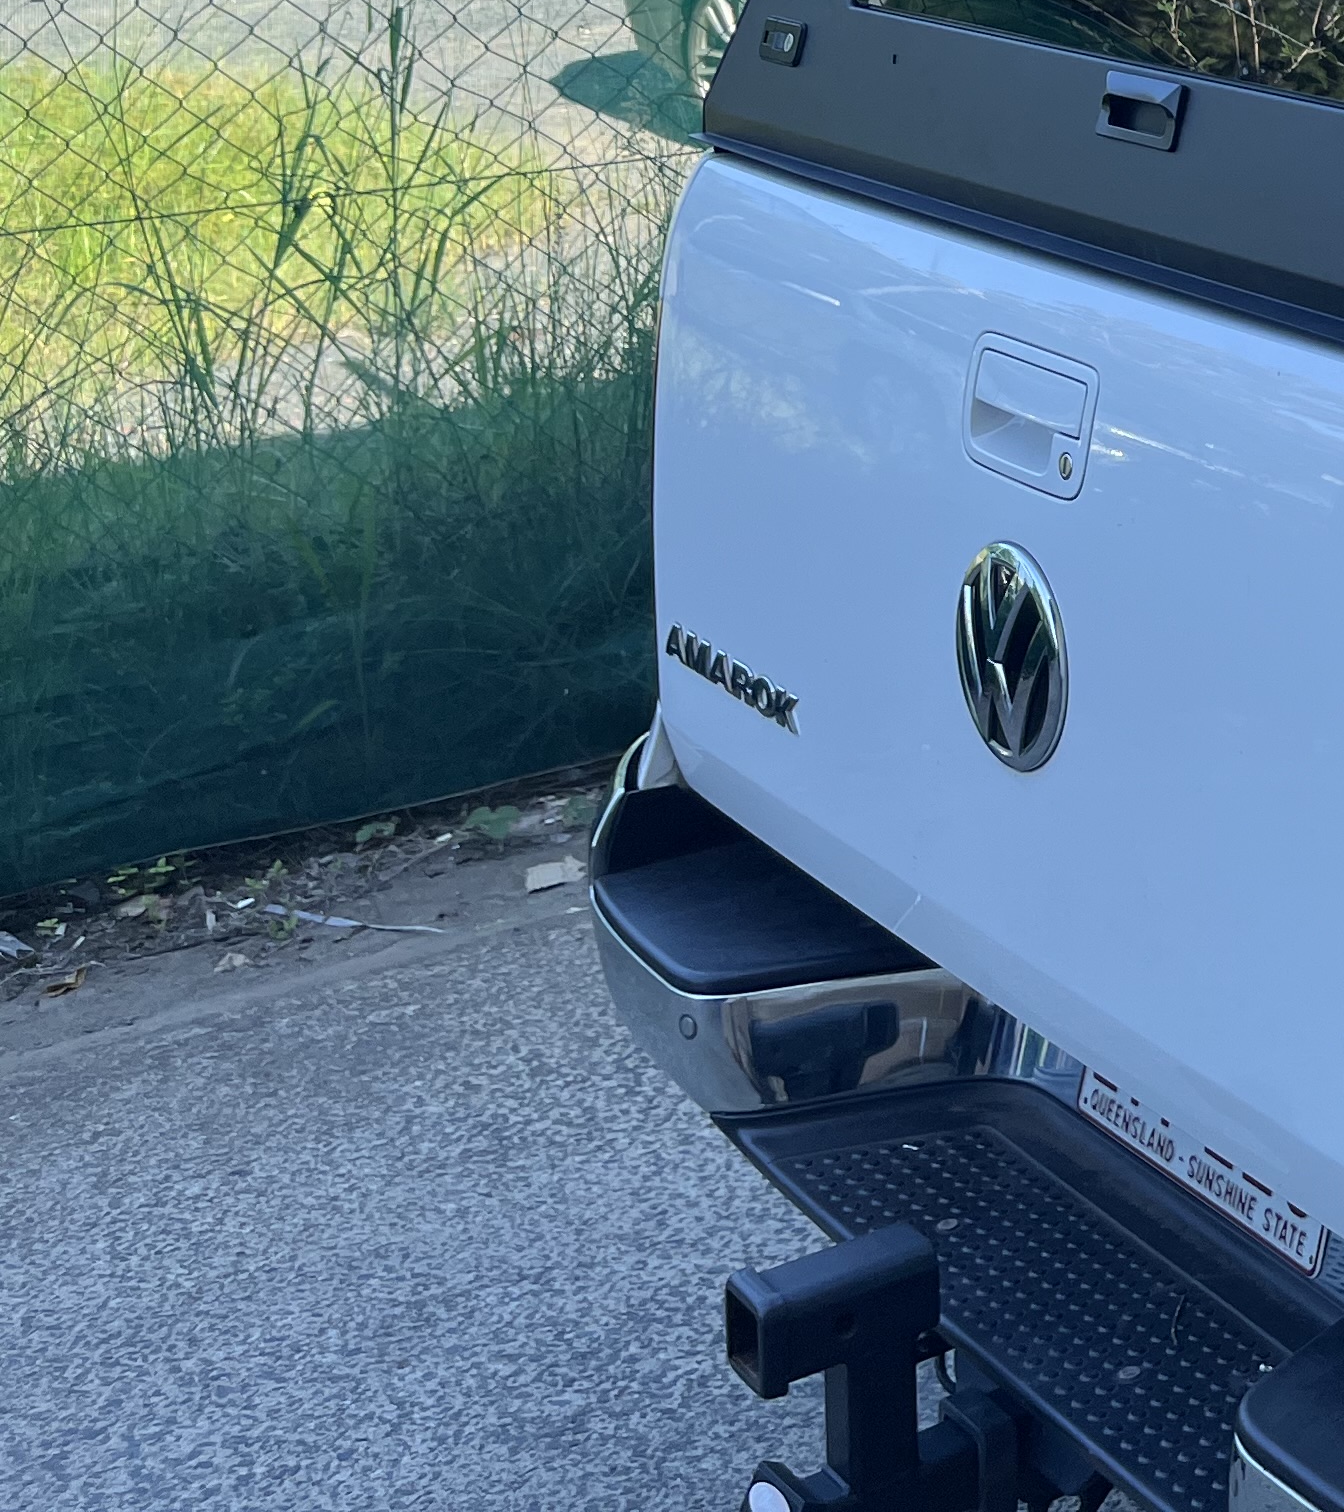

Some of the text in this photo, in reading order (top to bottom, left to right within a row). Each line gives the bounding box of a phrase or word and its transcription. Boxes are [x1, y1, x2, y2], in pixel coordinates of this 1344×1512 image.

[665, 620, 801, 736] AMAROK
[1090, 1088, 1175, 1163] QUEENSLAND
[1188, 1155, 1258, 1220] SUNSHINE
[1262, 1207, 1307, 1256] STATE
